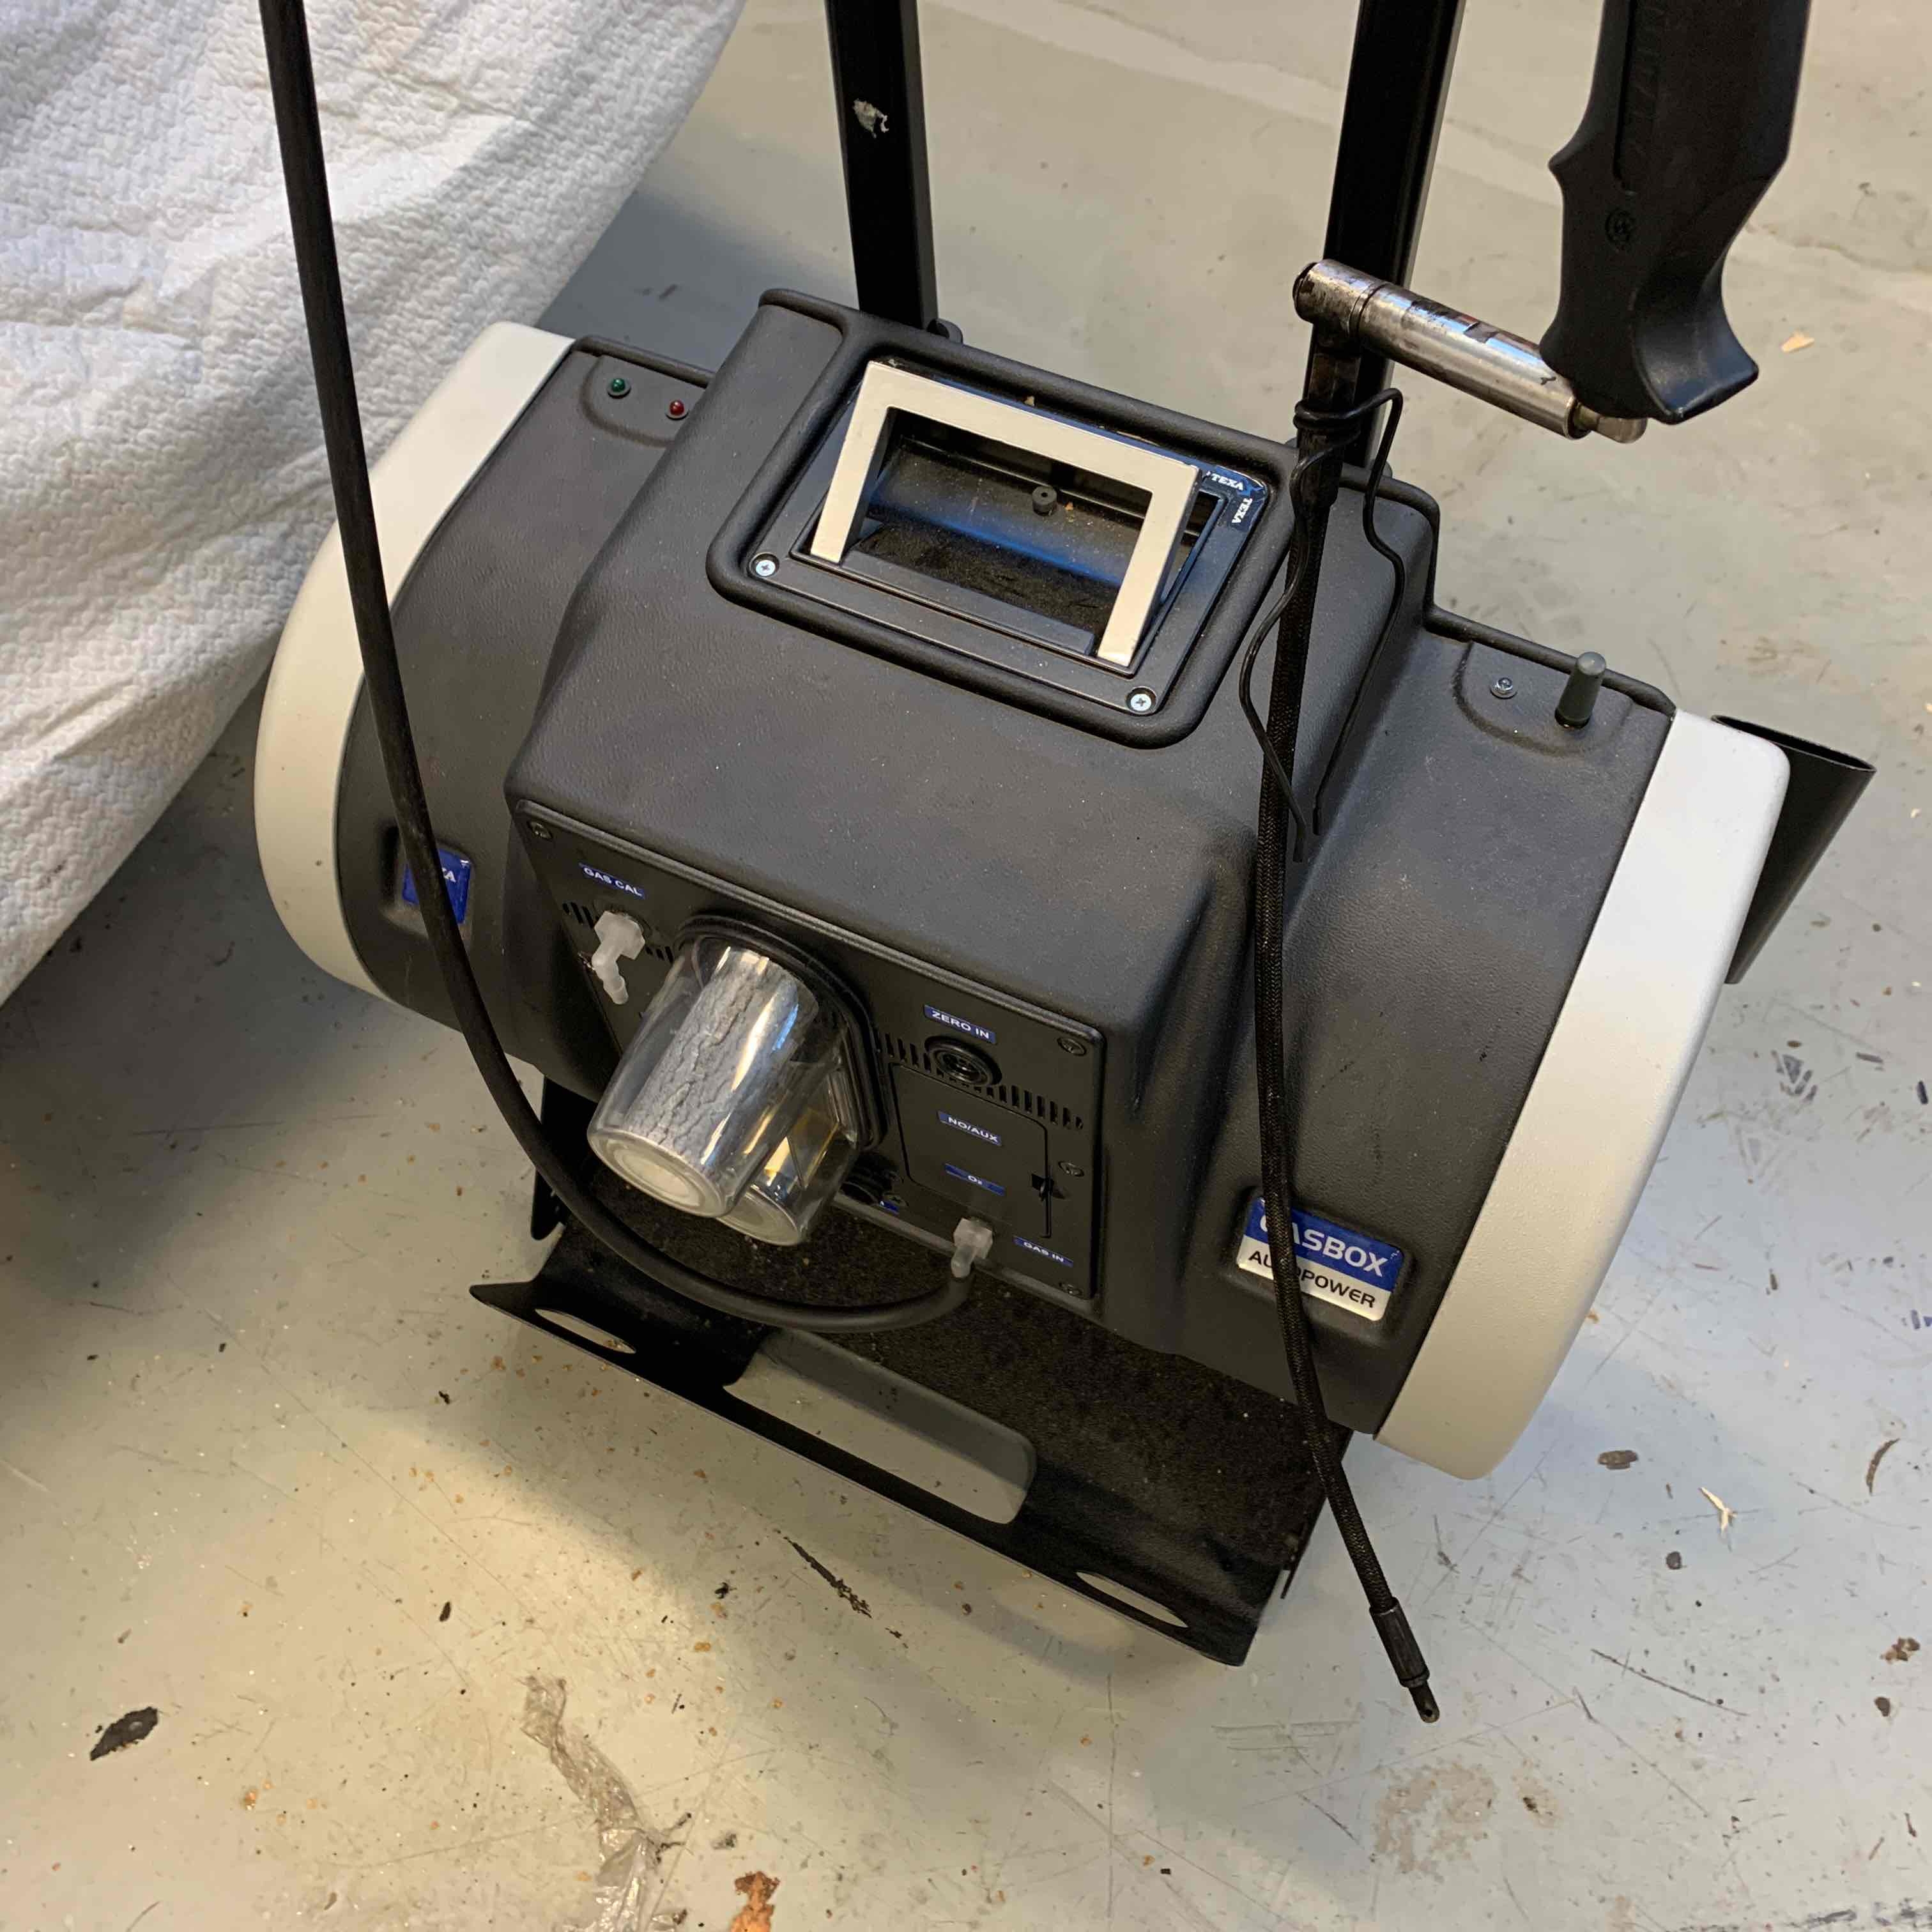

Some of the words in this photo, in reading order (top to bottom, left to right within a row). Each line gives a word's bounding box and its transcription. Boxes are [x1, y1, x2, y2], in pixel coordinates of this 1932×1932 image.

[1211, 473, 1244, 491] TEXA
[1231, 498, 1253, 524] TEXA
[583, 867, 612, 884] GAS
[615, 880, 642, 896] CAL
[931, 1010, 972, 1032] ZERO
[975, 1027, 990, 1039] IN
[947, 1116, 999, 1143] NO/AUX
[1052, 1253, 1064, 1263] IN
[1248, 1250, 1376, 1308] AUPOWER
